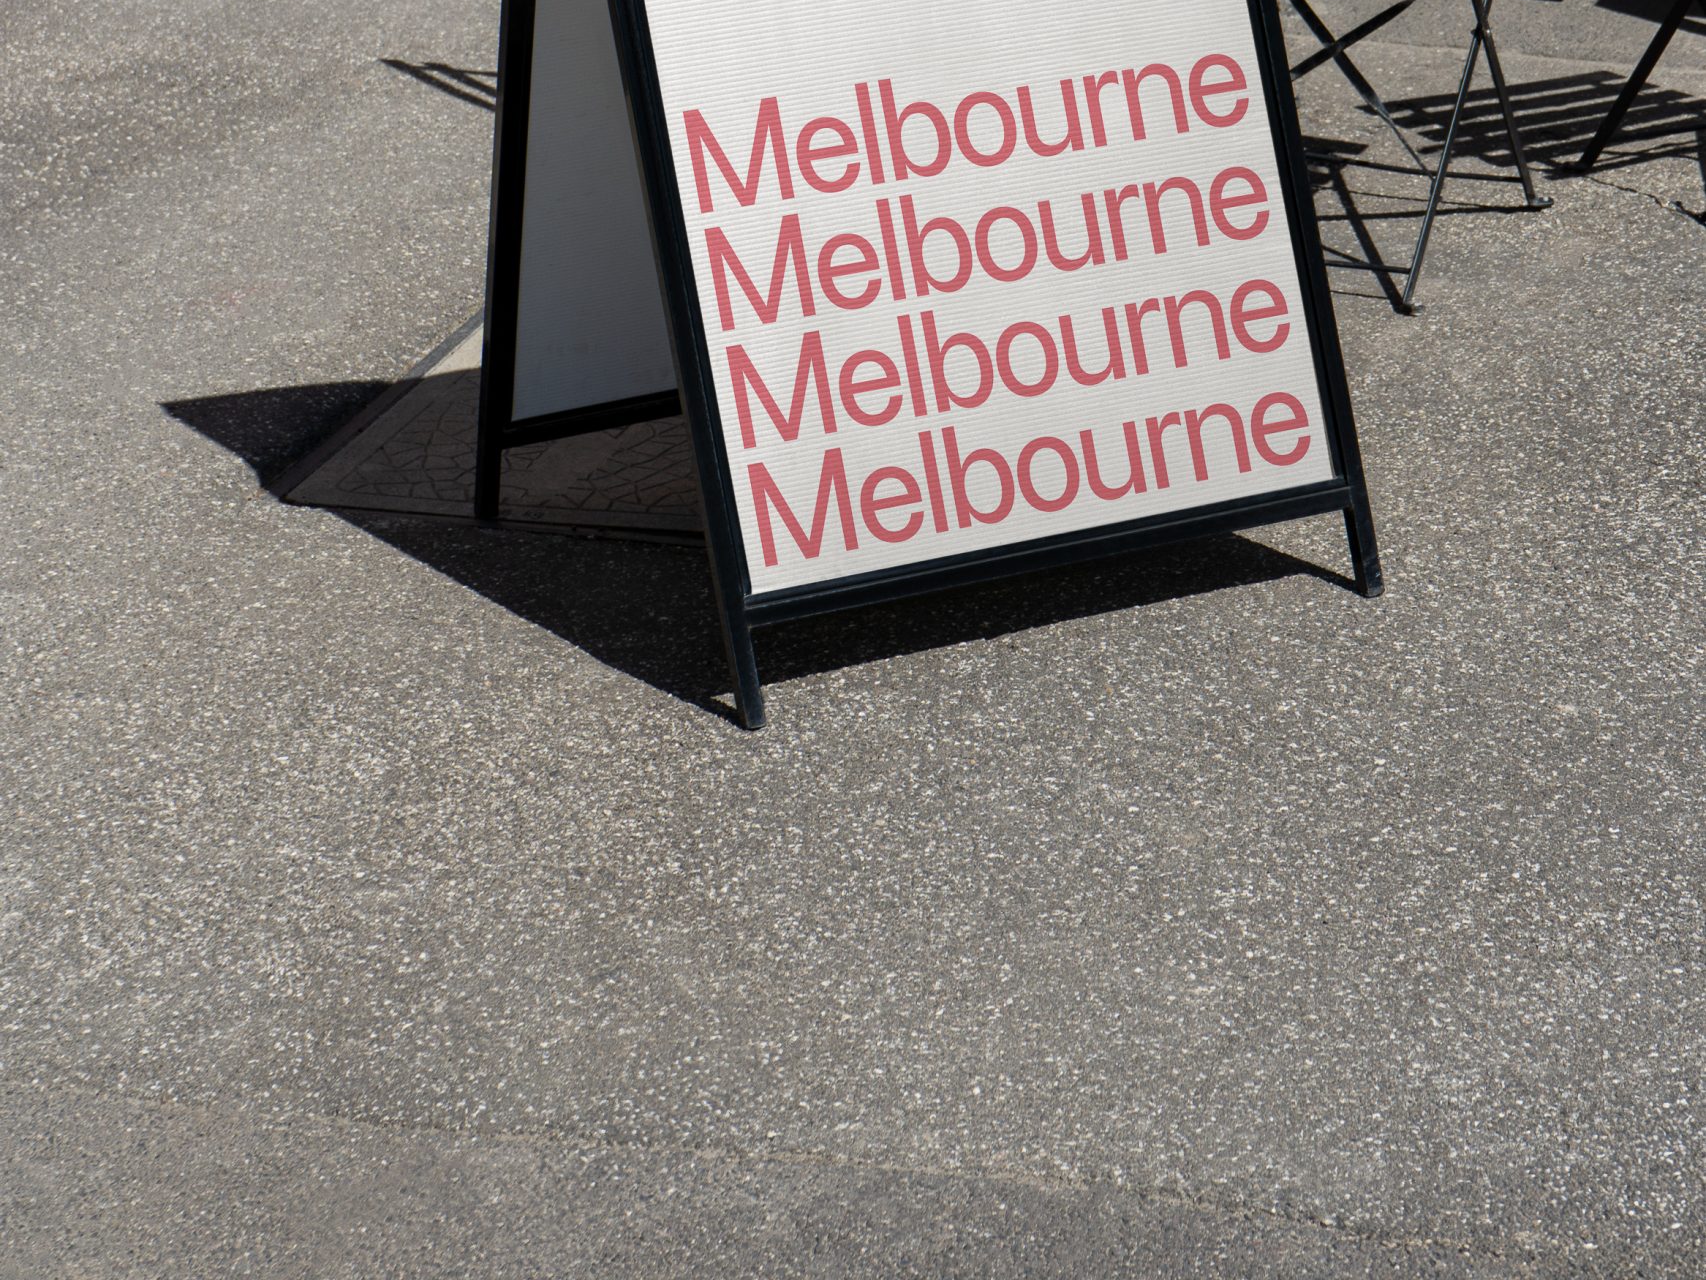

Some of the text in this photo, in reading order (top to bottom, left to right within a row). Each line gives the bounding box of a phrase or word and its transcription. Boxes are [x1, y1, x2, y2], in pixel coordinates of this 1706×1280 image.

[683, 54, 1249, 213] Melbourne
[704, 167, 1270, 330] Melbourne
[726, 280, 1290, 448] Melbourne
[748, 392, 1310, 566] Melbourne
